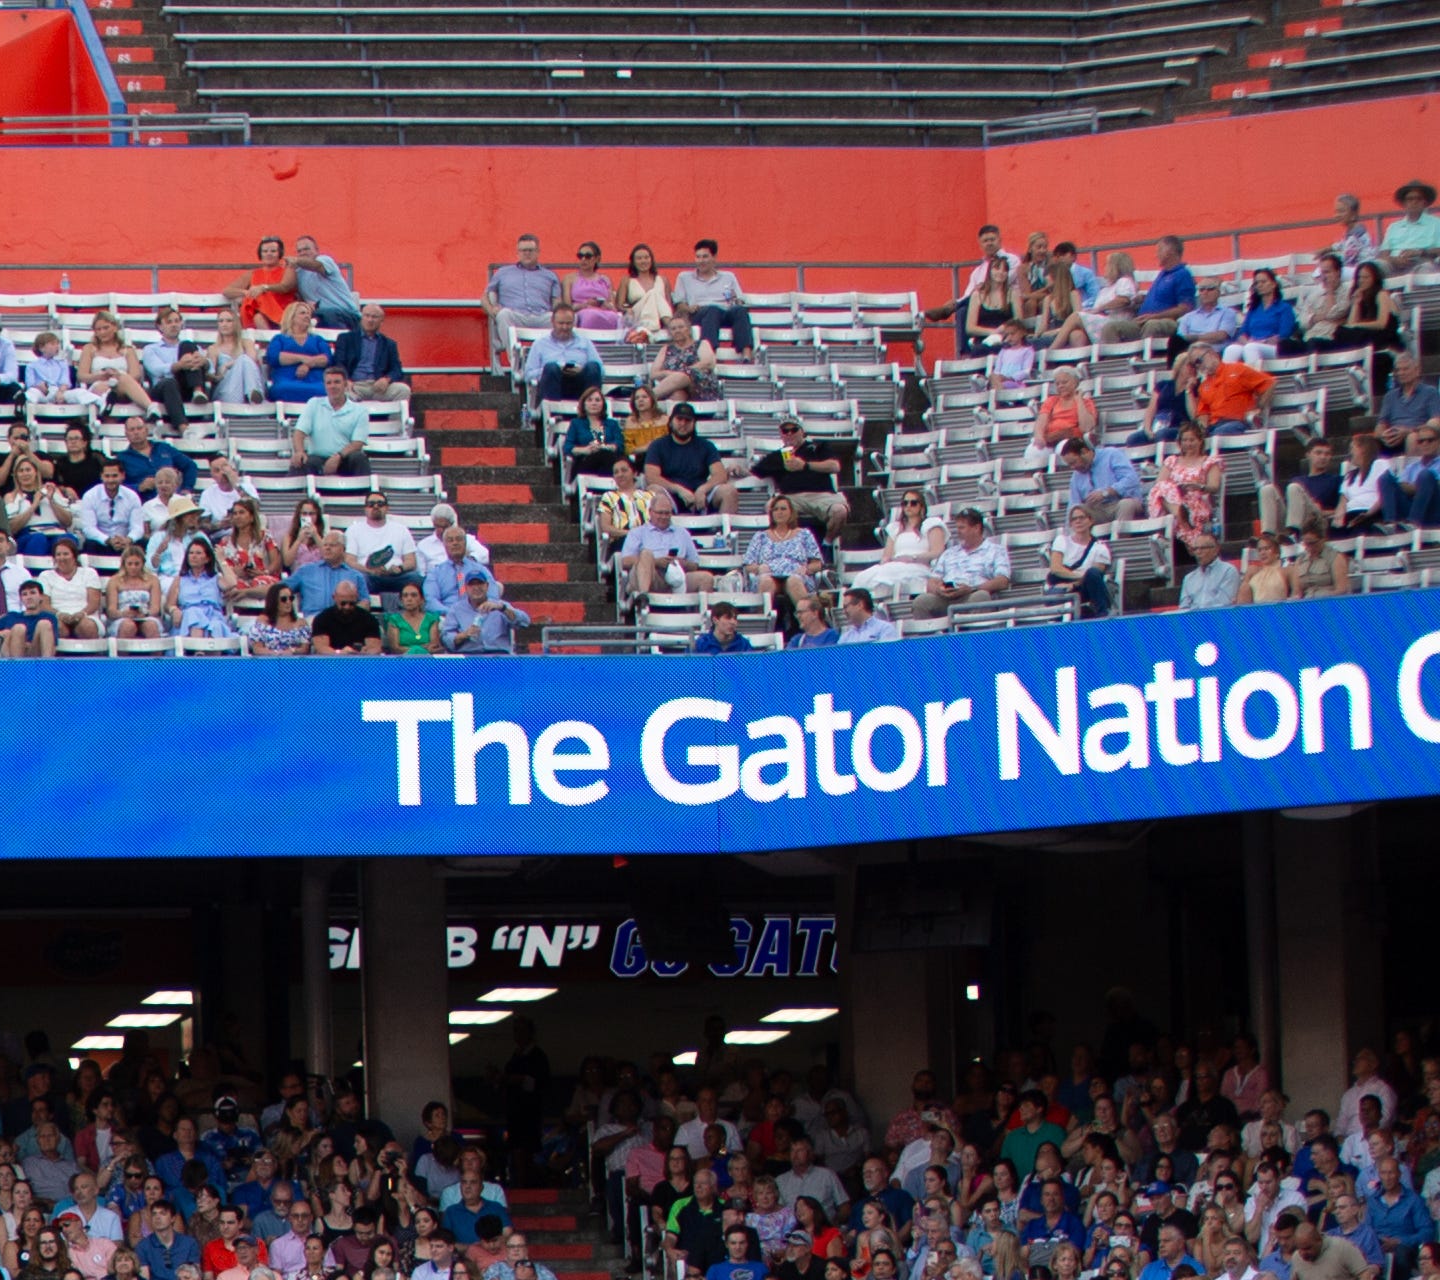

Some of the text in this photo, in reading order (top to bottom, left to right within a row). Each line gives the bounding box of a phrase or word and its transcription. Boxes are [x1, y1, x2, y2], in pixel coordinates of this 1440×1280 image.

[361, 693, 610, 806] The
[641, 694, 971, 805] Gator
[996, 642, 1371, 780] Nation
[328, 926, 478, 969] GB
